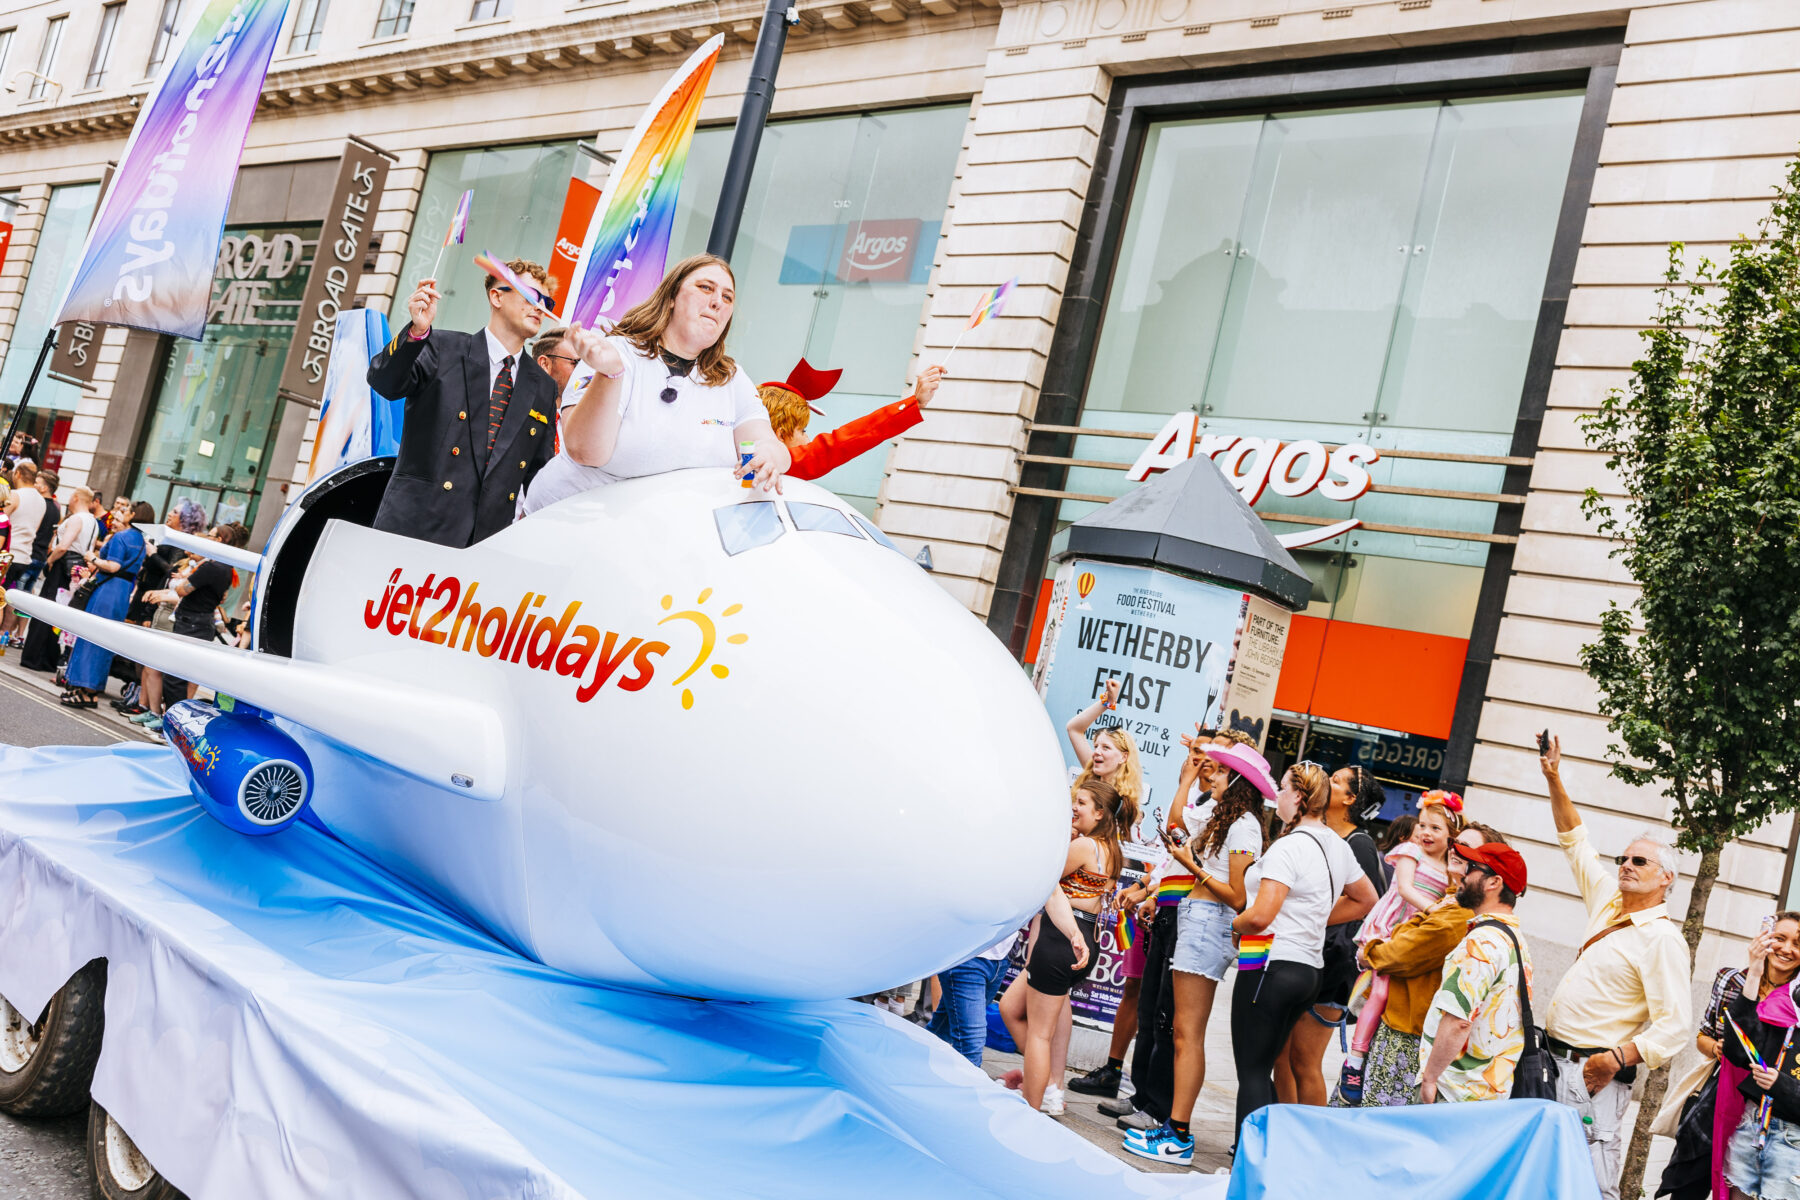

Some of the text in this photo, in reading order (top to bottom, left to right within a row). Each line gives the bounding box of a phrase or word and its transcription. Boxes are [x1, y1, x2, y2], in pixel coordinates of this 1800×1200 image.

[215, 233, 303, 280] ROAD
[556, 237, 582, 256] Argo
[848, 232, 908, 260] Argos
[308, 193, 369, 354] BROAD GATE
[206, 280, 272, 325] ATE
[1125, 411, 1380, 507] Argos
[1116, 593, 1176, 616] FOOD FESTIVAL
[1130, 609, 1156, 619] WETHERBY
[1252, 614, 1285, 636] PART OF THE
[1077, 616, 1212, 673] WETHERBY
[1249, 636, 1258, 649] THE
[1160, 727, 1170, 741] &
[1138, 740, 1170, 757] JULY
[1125, 871, 1143, 879] TICKE
